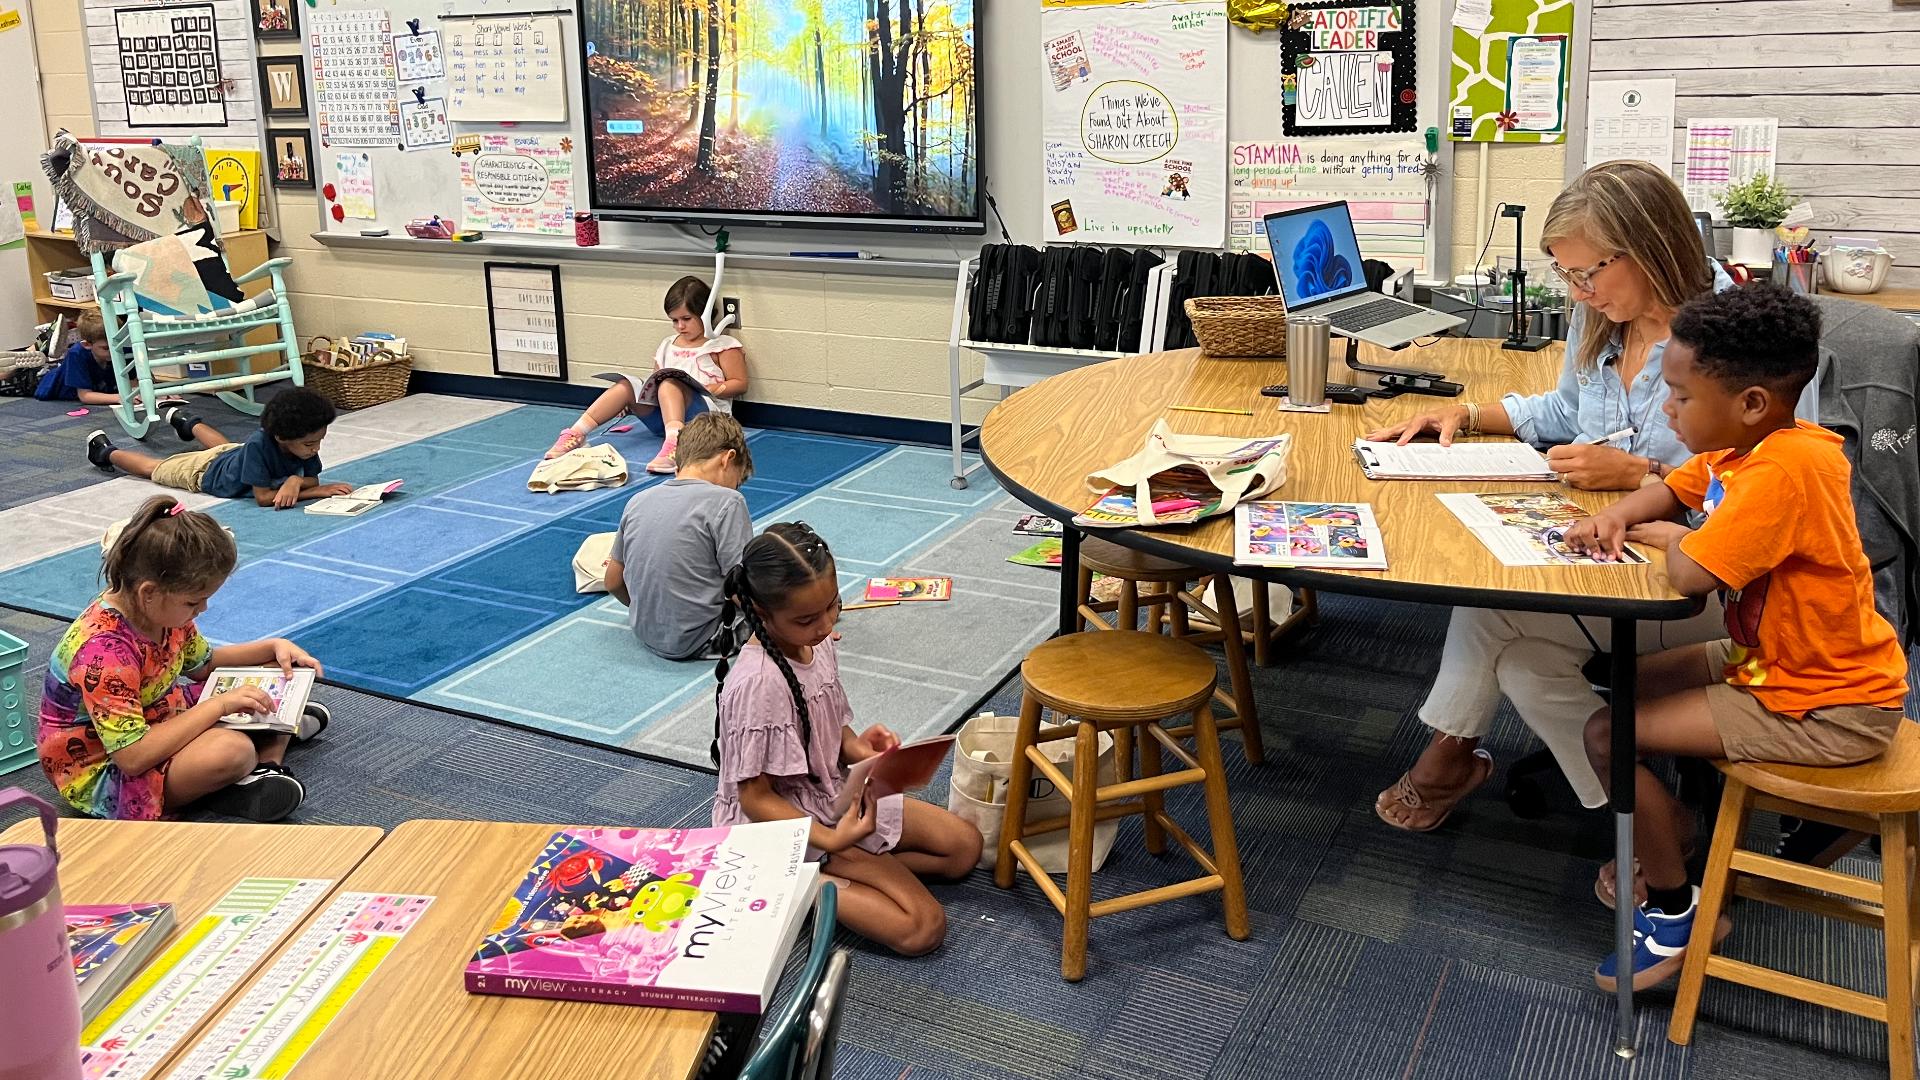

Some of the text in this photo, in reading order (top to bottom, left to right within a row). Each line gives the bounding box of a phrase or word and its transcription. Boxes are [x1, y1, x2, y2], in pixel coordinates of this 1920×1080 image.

[477, 22, 532, 34] Short Vowel Words
[1056, 42, 1074, 52] SMART
[1312, 30, 1376, 50] LEADER
[1052, 46, 1082, 60] SCHOOL
[271, 72, 300, 101] W
[1100, 94, 1162, 116] Things We've
[1088, 112, 1112, 128] Found
[1136, 112, 1168, 128] About
[1088, 133, 1172, 150] SHARON CREECH
[1234, 144, 1421, 169] STAMINA is doing anything for a
[481, 160, 526, 170] CHARACTERISTICS
[1164, 164, 1192, 172] SCHOOL
[1234, 162, 1419, 181] long period of time without getting tired
[1252, 176, 1277, 191] giving
[1084, 218, 1104, 232] Live
[518, 293, 553, 304] DAYS SPENT
[528, 362, 541, 371] DAYS
[683, 847, 746, 959] myView
[722, 864, 759, 941] LITERACY
[504, 977, 567, 998] myView
[572, 986, 628, 996] LITERACY
[640, 991, 674, 1000] STUDENT
[677, 993, 726, 1004] INTERACTIVE
